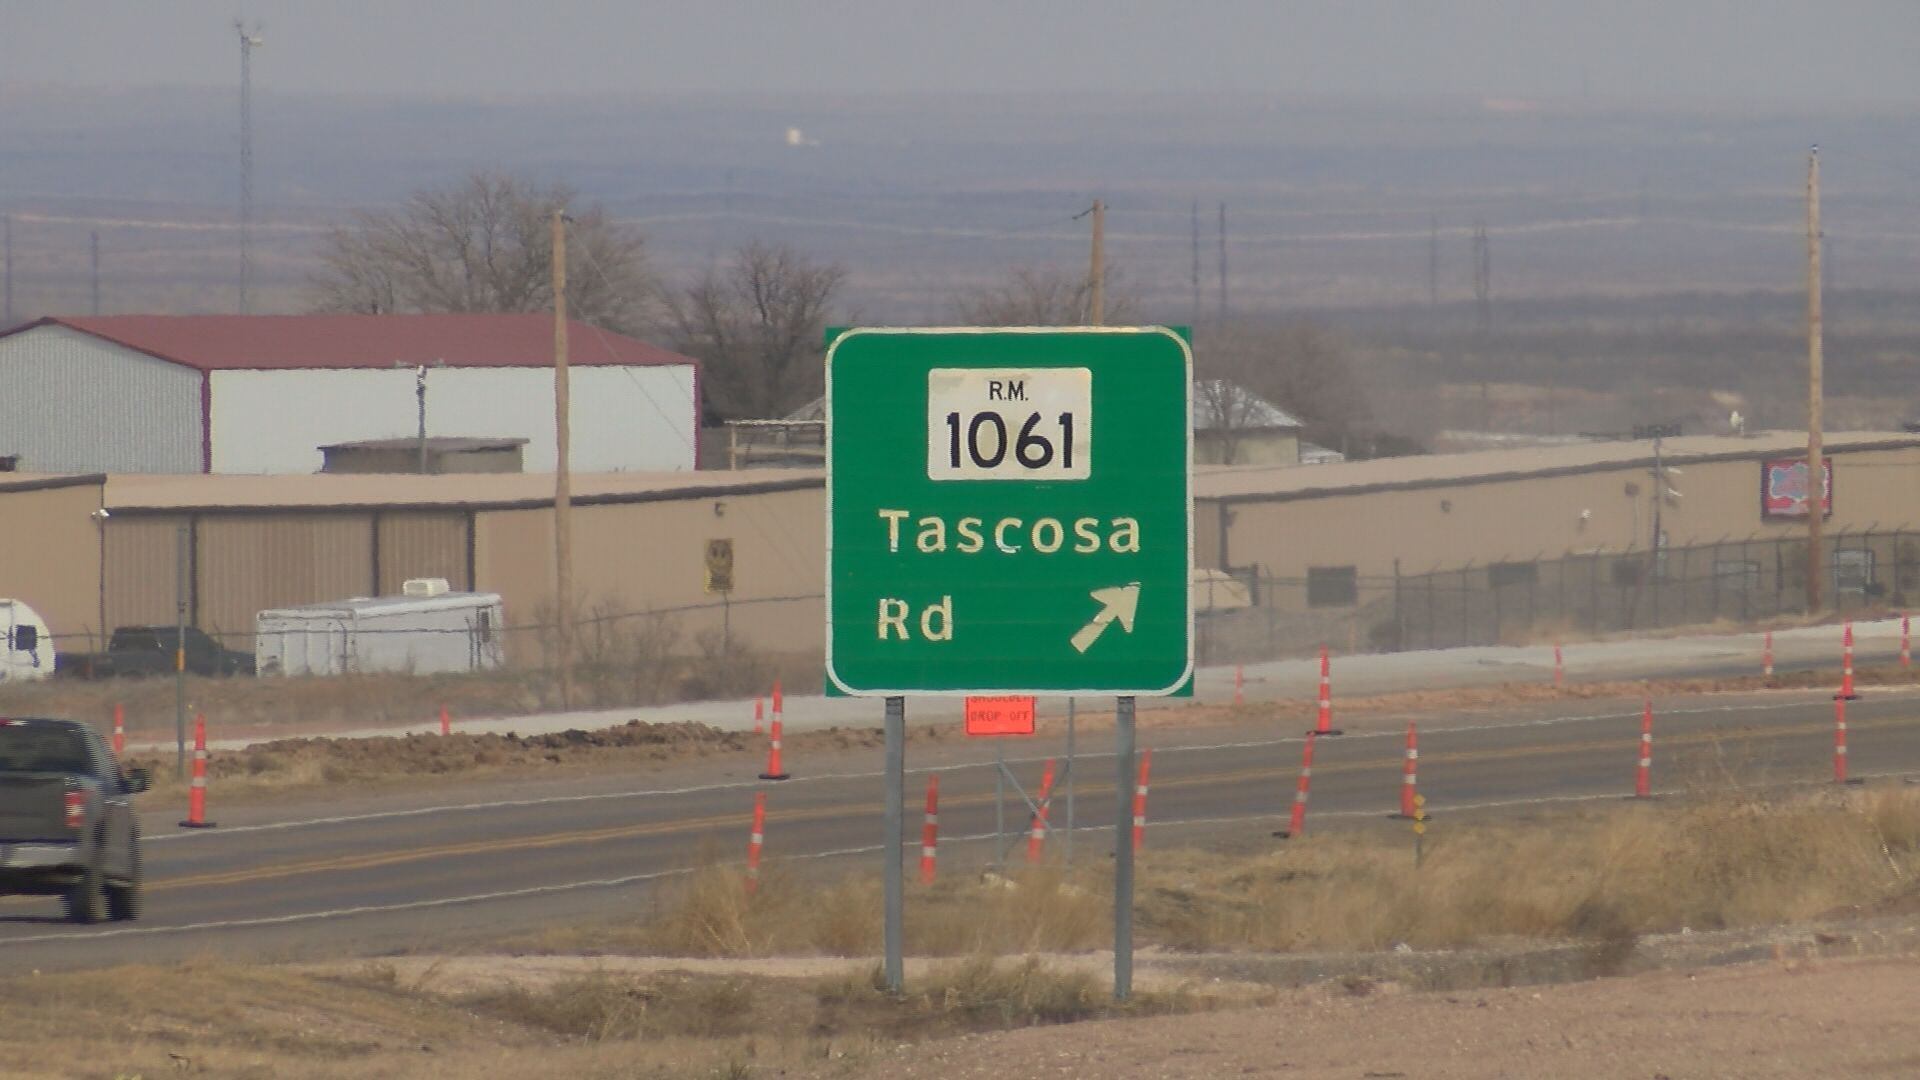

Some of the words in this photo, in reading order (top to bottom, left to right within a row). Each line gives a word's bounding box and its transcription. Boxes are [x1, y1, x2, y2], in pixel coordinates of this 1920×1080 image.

[989, 381, 1029, 401] R.M.
[946, 411, 1073, 468] 1061
[879, 509, 1141, 553] Tascosa
[878, 595, 953, 641] Rd
